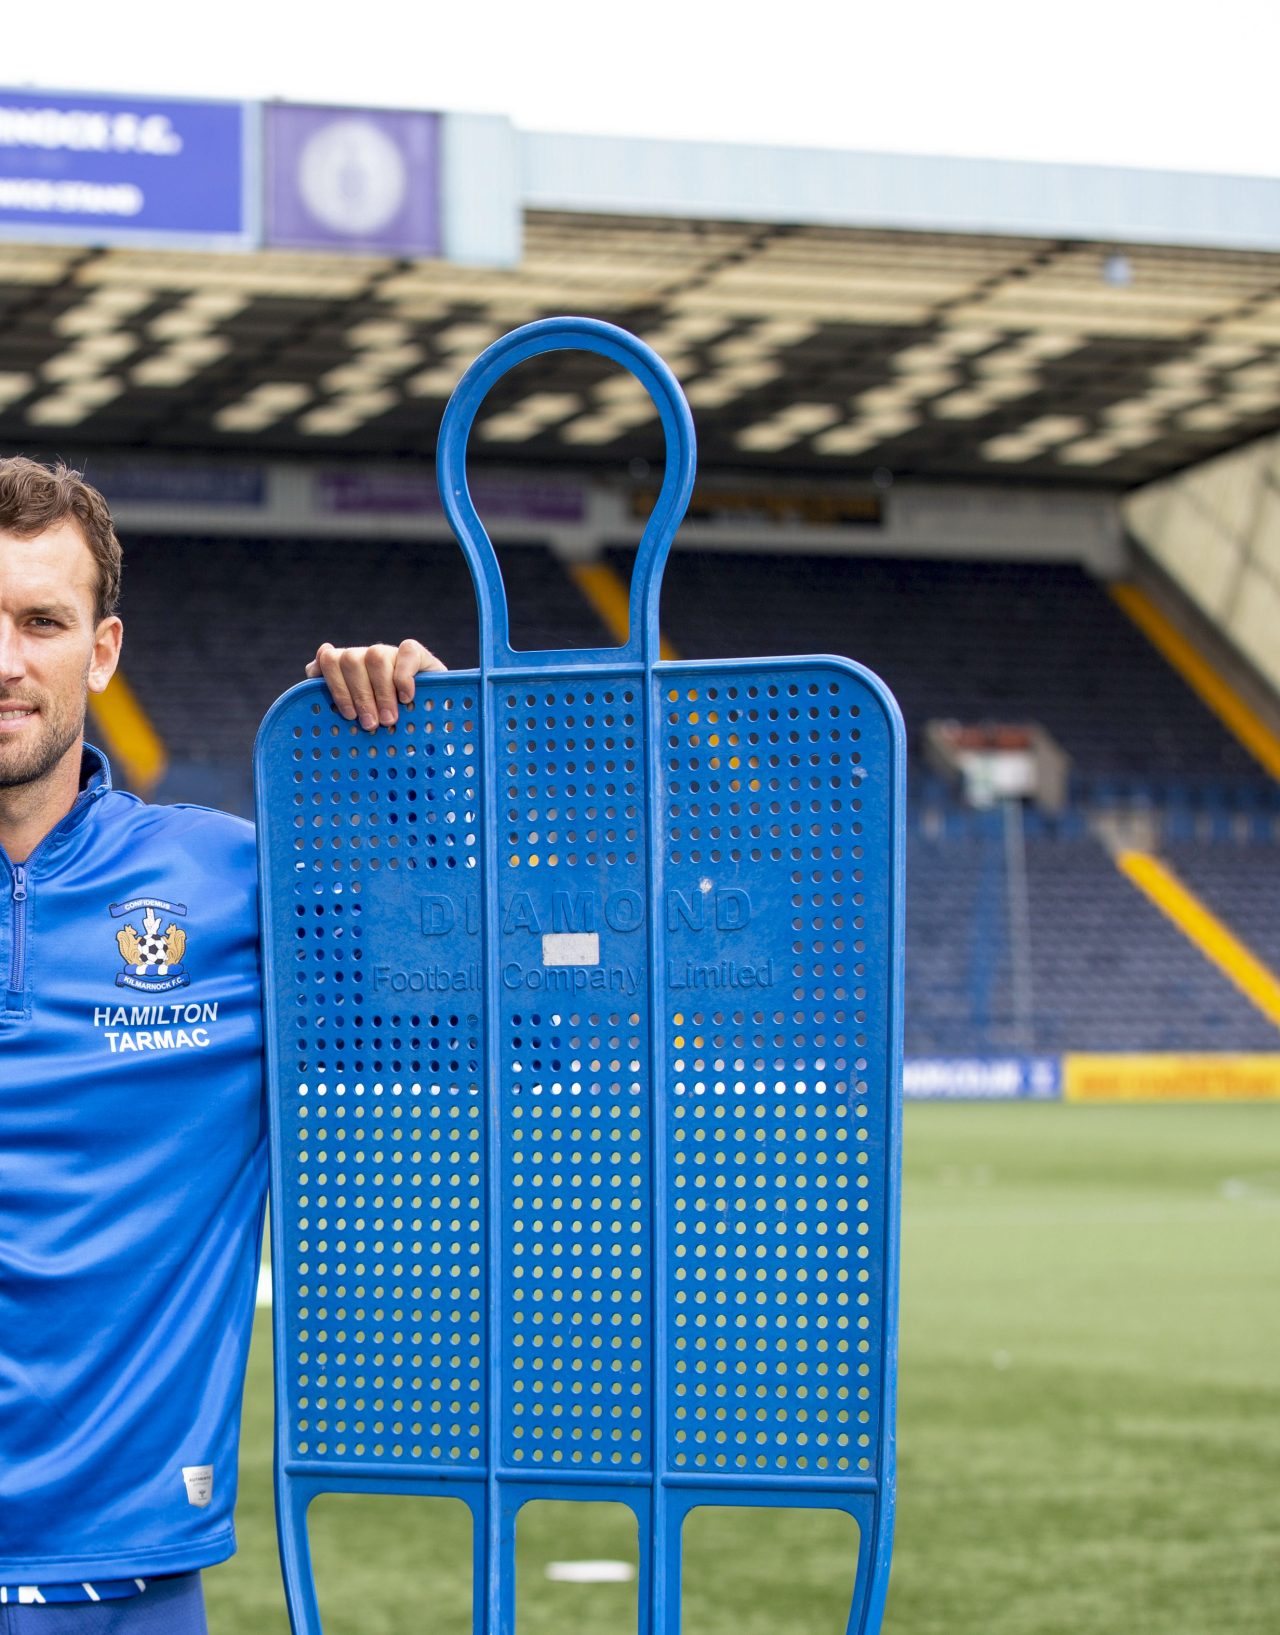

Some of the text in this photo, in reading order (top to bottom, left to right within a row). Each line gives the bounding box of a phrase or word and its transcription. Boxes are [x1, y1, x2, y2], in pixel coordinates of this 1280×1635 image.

[124, 899, 171, 910] CONFIDEMUS
[421, 887, 752, 935] DIAMOND
[123, 976, 184, 990] KILMARNOCK F.C.
[373, 958, 774, 996] Football Company Limited
[94, 1002, 218, 1027] HAMILTON
[104, 1028, 210, 1053] TARMAC
